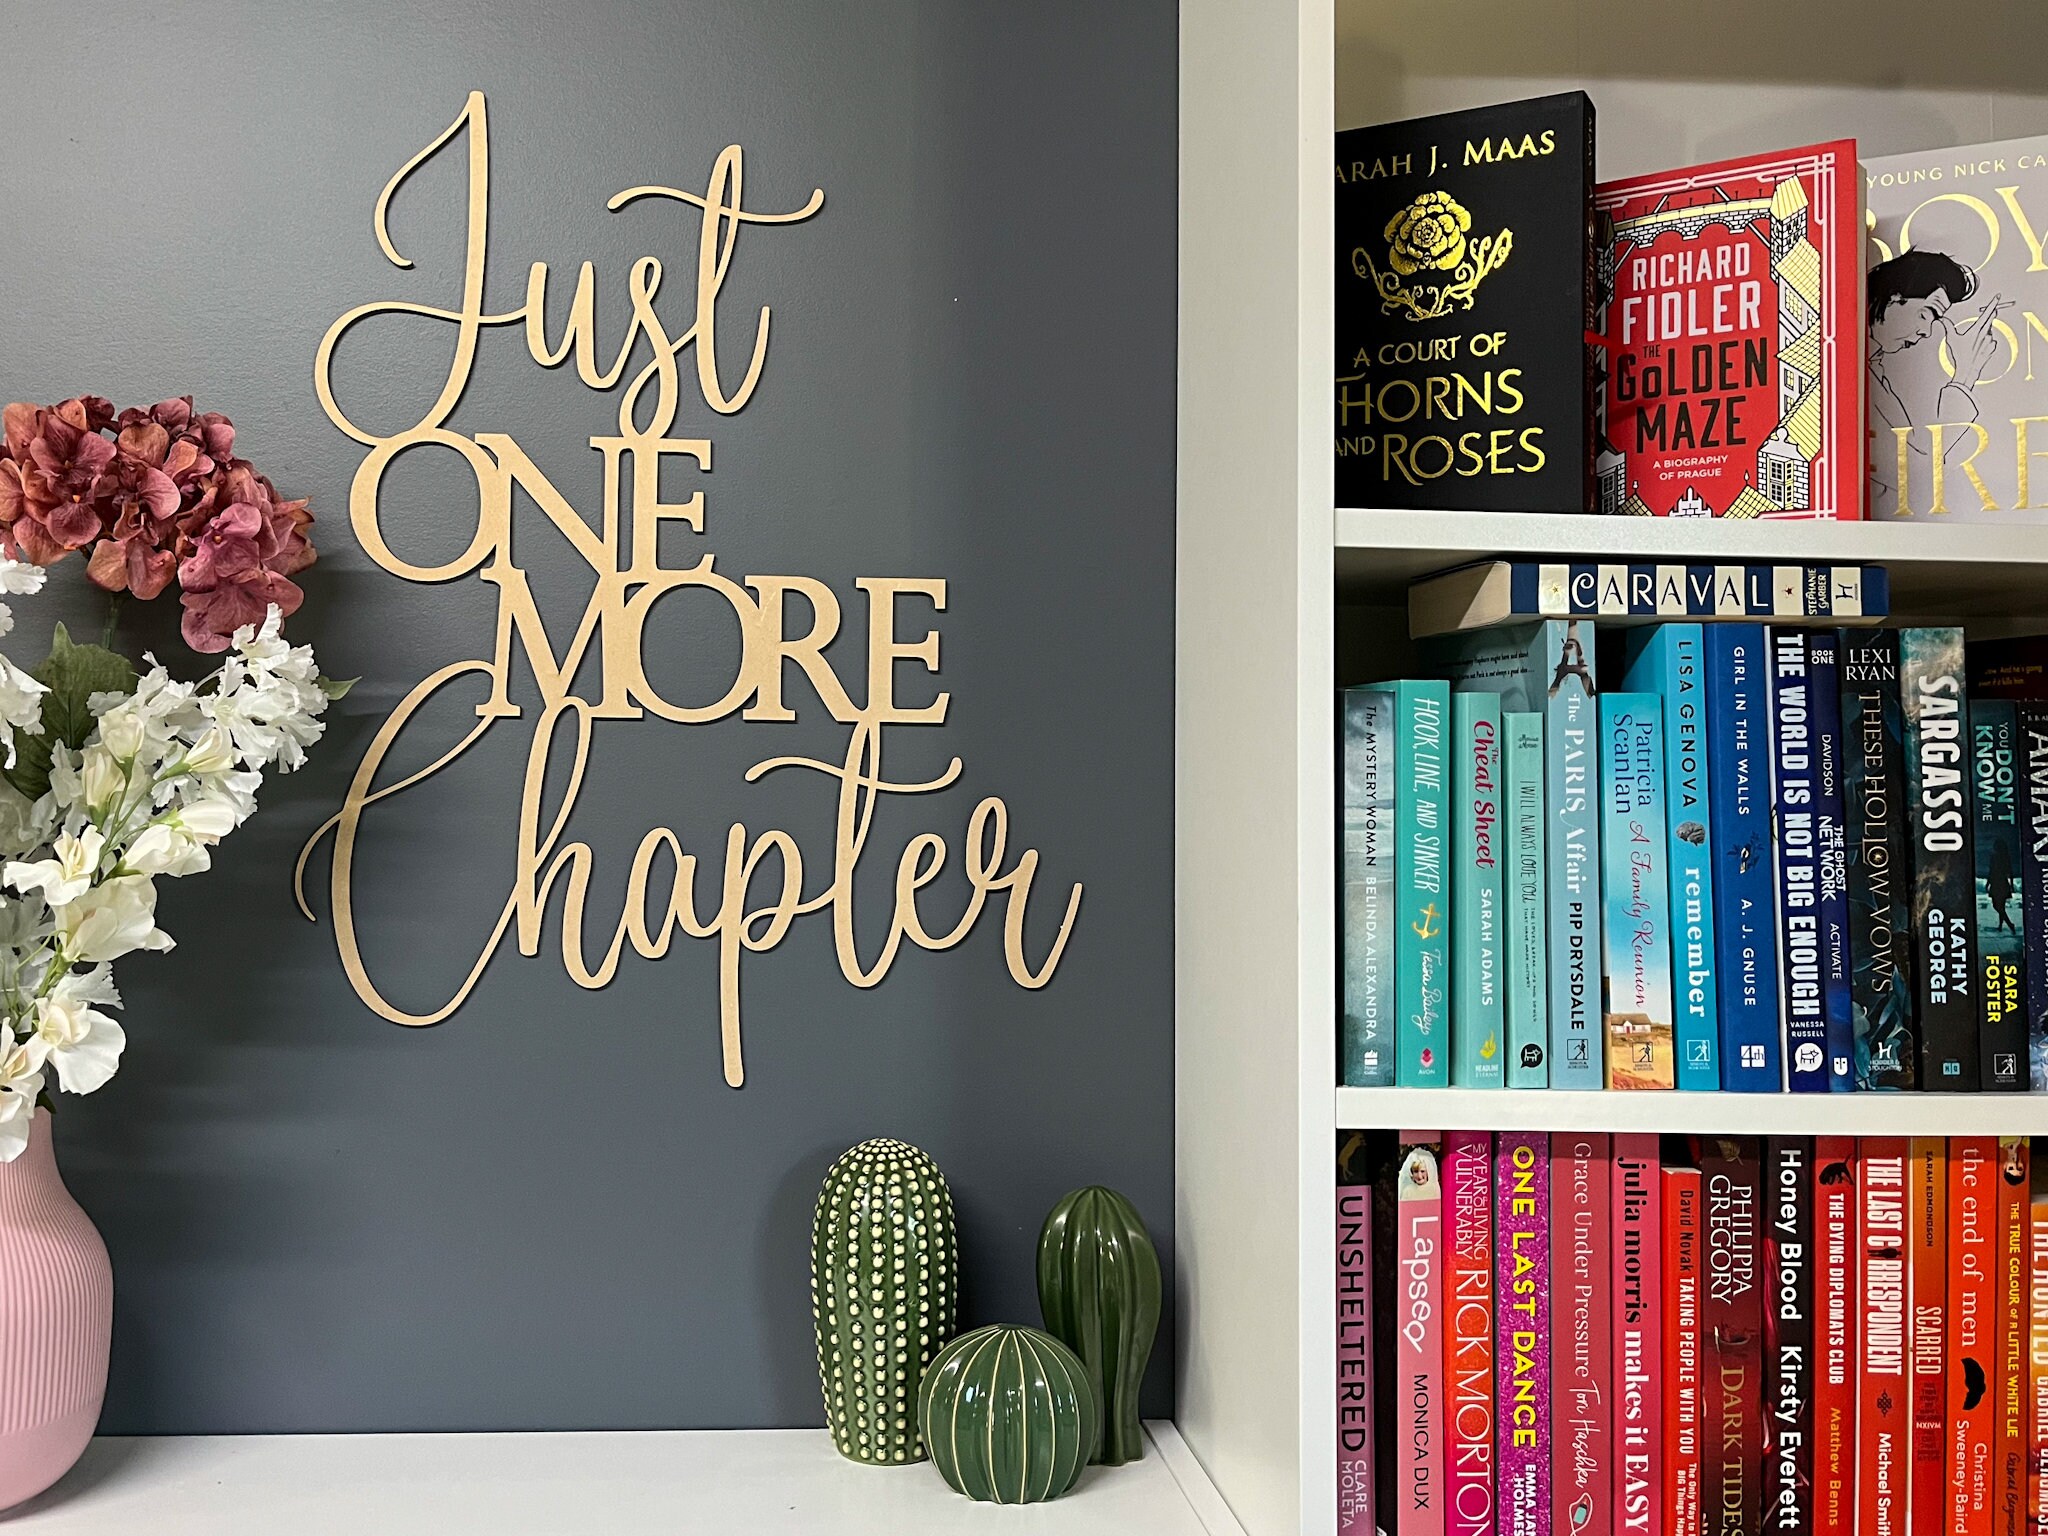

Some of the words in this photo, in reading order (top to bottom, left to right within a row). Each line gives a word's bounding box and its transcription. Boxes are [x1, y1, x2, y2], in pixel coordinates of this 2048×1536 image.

[1462, 129, 1556, 168] MAAS
[1866, 167, 1943, 189] YOUNG
[1954, 159, 2006, 178] NICK
[314, 91, 823, 440] Just
[1631, 242, 1750, 291] RICHARD
[1622, 280, 1760, 345] FIDLER
[1353, 347, 1371, 368] A
[1378, 335, 1462, 366] COURT
[1469, 331, 1507, 358] OF
[1643, 344, 1661, 359] THE
[1636, 396, 1747, 453] MAZE
[1384, 427, 1546, 486] ROSES
[1653, 459, 1661, 469] A
[1663, 454, 1728, 468] BIOGRAPHY
[1659, 470, 1674, 480] OF
[1677, 467, 1722, 479] PRAGUE
[349, 433, 715, 581] ONE
[1571, 572, 1769, 609] CARAVAL
[1805, 568, 1817, 615] STEPHANIE
[1818, 574, 1829, 609] GARBER
[477, 569, 950, 723] MORE
[1679, 642, 1694, 693] LISA
[1734, 646, 1745, 685] GIRL
[1777, 634, 1805, 677] THE
[1811, 656, 1834, 665] ONE
[1845, 665, 1895, 681] RYAN
[1849, 648, 1891, 663] LEXI
[1365, 706, 1376, 727] The
[1413, 698, 1440, 749] HOOK,
[1568, 693, 1580, 722] The
[1735, 693, 1746, 711] IN
[1779, 685, 1809, 770] WORLD
[1858, 689, 1883, 768] THESE
[1474, 721, 1495, 794] Cheat
[1680, 704, 1696, 808] GENOVA
[1736, 719, 1747, 751] THE
[1998, 721, 2009, 749] YOU
[1365, 733, 1377, 800] MYSTERY
[1413, 753, 1440, 792] LINE,
[1564, 729, 1586, 812] PARIS
[1613, 714, 1635, 814] Scanlan
[1636, 722, 1655, 807] Patricia
[1737, 759, 1749, 815] WALLS
[1821, 734, 1833, 796] DAVIDSON
[1918, 675, 1963, 852] SARGASSO
[1975, 725, 1995, 802] KNOW
[1995, 749, 2015, 825] DON'T
[1416, 800, 1438, 829] AND
[1783, 779, 1811, 804] IS
[1982, 804, 1993, 822] ME
[1365, 806, 1377, 866] WOMAN
[1474, 800, 1495, 870] Sheet
[1520, 814, 1536, 851] ALWAYS
[1784, 813, 1813, 858] NOT
[1818, 815, 1836, 901] NETWORK
[1833, 825, 1843, 848] THE
[1862, 774, 1890, 897] HOLLOW
[295, 660, 1082, 1087] Chapter
[1413, 833, 1440, 893] SINKER
[1520, 854, 1537, 878] LOVE
[1622, 850, 1652, 918] Family
[1787, 866, 1815, 907] BIG
[1834, 849, 1846, 892] GHOST
[1365, 877, 1377, 942] BELINDA
[1481, 888, 1492, 941] SARAH
[1569, 902, 1582, 930] PIP
[1741, 898, 1753, 916] A.
[1631, 921, 1654, 1008] Reunion
[1685, 867, 1710, 1018] remember
[1788, 915, 1820, 1015] ENOUGH
[1830, 923, 1842, 980] ACTIVATE
[1869, 905, 1894, 992] VOWS
[1927, 909, 1947, 1004] GEORGE
[1950, 918, 1968, 996] KATHY
[1365, 946, 1377, 1040] ALEXANDRA
[1481, 949, 1493, 1006] ADAMS
[1570, 936, 1584, 1030] DRYSDALE
[1743, 947, 1756, 1006] GNUSE
[1985, 955, 2001, 1023] FOSTER
[2003, 965, 2018, 1013] SARA
[1412, 987, 1442, 1035] Bailey
[1790, 1020, 1824, 1028] VANESSA
[1791, 1030, 1824, 1038] RUSSELL
[1472, 1143, 1487, 1153] MY
[1472, 1153, 1488, 1196] YEAR
[1574, 1142, 1592, 1204] Grace
[1867, 1157, 1902, 1186] THE
[1962, 1147, 1985, 1187] the
[1456, 1144, 1473, 1260] VULNERABLY
[1512, 1146, 1535, 1216] ONE
[1618, 1156, 1648, 1222] julia
[1679, 1190, 1694, 1226] David
[1775, 1150, 1801, 1234] Honey
[1829, 1193, 1844, 1219] THE
[1473, 1207, 1489, 1260] LIVING
[1867, 1191, 1902, 1231] LAST
[1962, 1196, 1985, 1244] end
[2009, 1223, 2021, 1254] TRUE
[2010, 1202, 2020, 1220] THE
[1574, 1211, 1593, 1279] Under
[1679, 1231, 1695, 1272] Novak
[1709, 1174, 1732, 1305] GREGORY
[1732, 1185, 1752, 1296] PHILIPPA
[1829, 1223, 1844, 1264] DYING
[1402, 1216, 1439, 1353] Lapsed
[1512, 1232, 1535, 1318] LAST
[1624, 1230, 1648, 1323] morris
[1780, 1243, 1802, 1320] Blood
[1962, 1253, 1985, 1282] of
[2008, 1257, 2021, 1306] COLOUR
[1339, 1195, 1365, 1452] UNSHELTERED
[1456, 1269, 1490, 1356] RICK
[1679, 1277, 1695, 1326] TAKING
[1829, 1268, 1844, 1346] DIPLOMATS
[1961, 1291, 1977, 1347] men
[1574, 1285, 1592, 1377] Pressure
[1679, 1331, 1695, 1383] PEOPLE
[1916, 1306, 1942, 1375] SCARRED
[2007, 1331, 2020, 1371] LITTLE
[1513, 1331, 1536, 1447] DANCE
[1624, 1331, 1649, 1420] makes
[1775, 1346, 1802, 1424] Kirsty
[1829, 1350, 1844, 1385] CLUB
[1413, 1374, 1429, 1461] MONICA
[1679, 1389, 1695, 1423] WITH
[1721, 1365, 1744, 1450] DARK
[2007, 1375, 2019, 1416] WHITE
[1625, 1426, 1649, 1446] it
[1679, 1427, 1695, 1455] YOU
[1829, 1407, 1842, 1474] Matthew
[2007, 1418, 2019, 1438] LIE
[1354, 1459, 1367, 1513] CLARE
[1414, 1467, 1429, 1510] DUX
[1525, 1464, 1537, 1509] EMMA
[1677, 1470, 1686, 1485] BIG
[1688, 1463, 1697, 1479] The
[1779, 1432, 1801, 1529] Everett
[1878, 1432, 1892, 1494] Michael
[1953, 1420, 1970, 1534] Sweeney-Baird
[1973, 1442, 1988, 1511] Christina
[1341, 1461, 1354, 1528] MOLETA
[1513, 1477, 1525, 1536] HOLMES
[1625, 1454, 1649, 1533] EASY
[1686, 1502, 1696, 1520] Way
[1829, 1480, 1841, 1526] Benns
